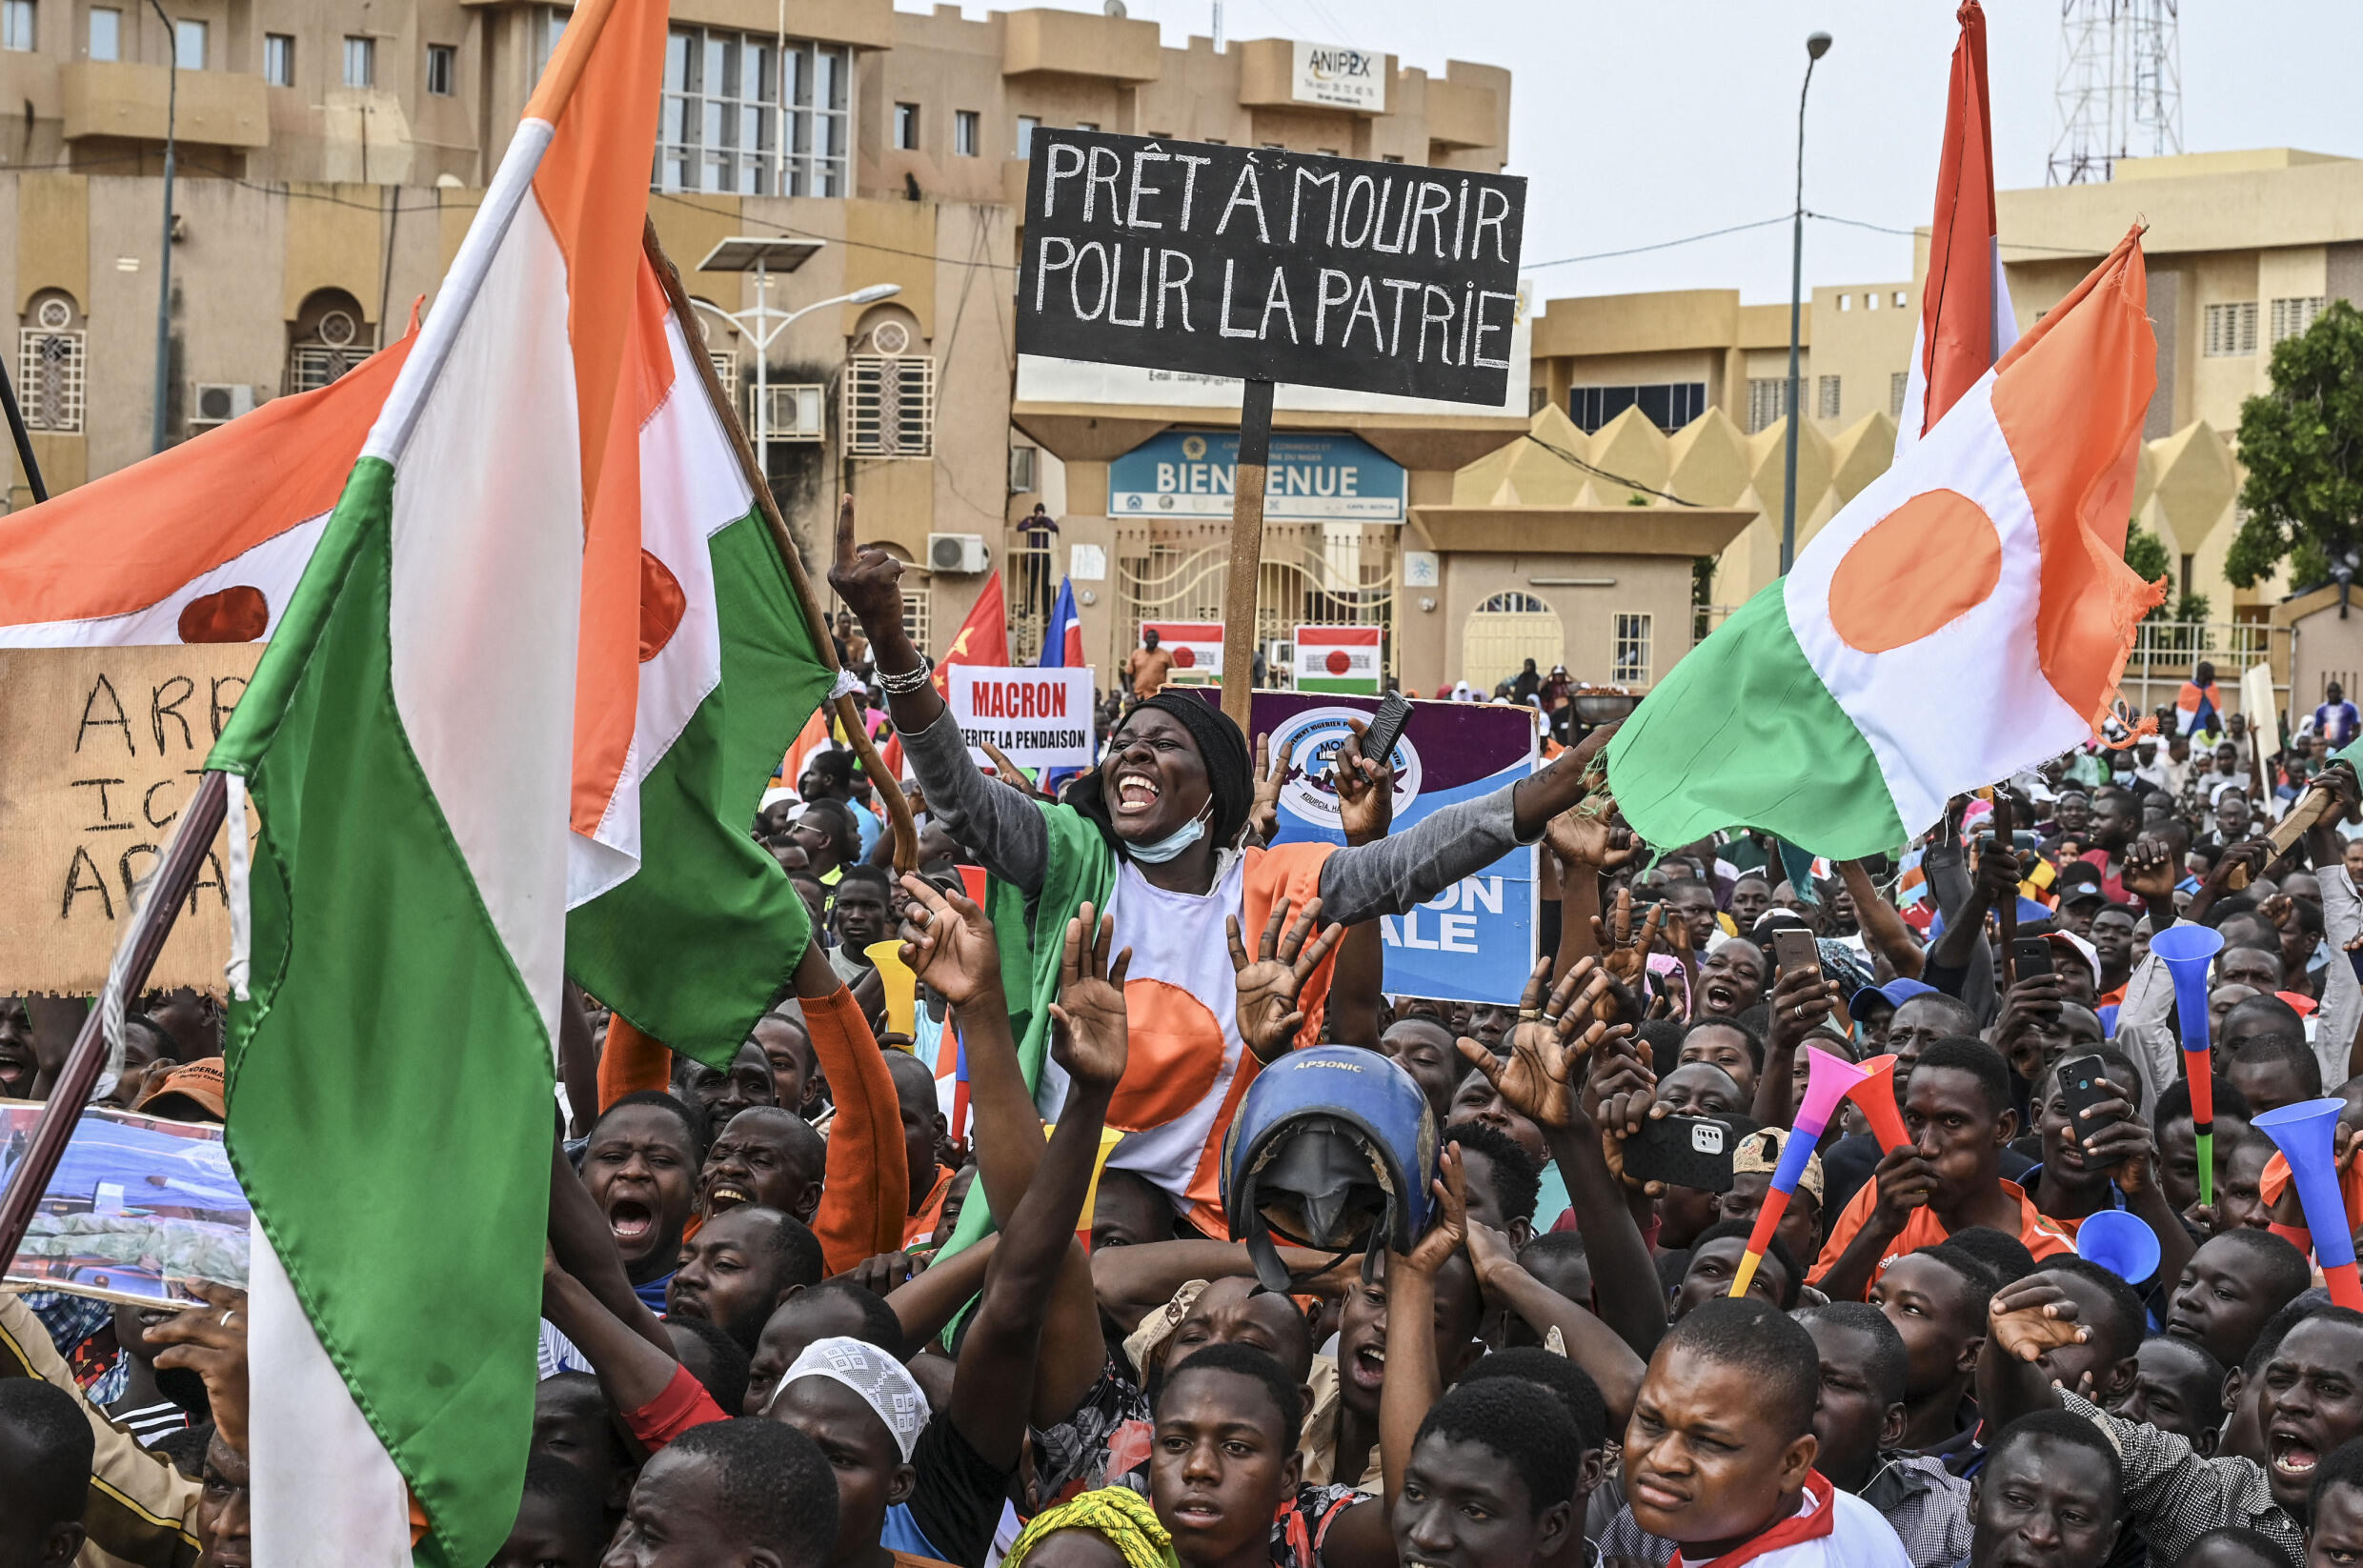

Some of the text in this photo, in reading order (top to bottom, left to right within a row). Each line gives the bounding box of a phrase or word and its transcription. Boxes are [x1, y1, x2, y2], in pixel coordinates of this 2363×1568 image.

[1044, 142, 1211, 231] PRÊT
[1215, 151, 1270, 243] À
[1036, 236, 1195, 332] POUR
[1220, 258, 1299, 345] LA
[1157, 462, 1358, 496] BIENENUE
[972, 680, 1066, 719] MACRON
[999, 731, 1013, 749] LA
[1016, 730, 1085, 749] PENDAISON
